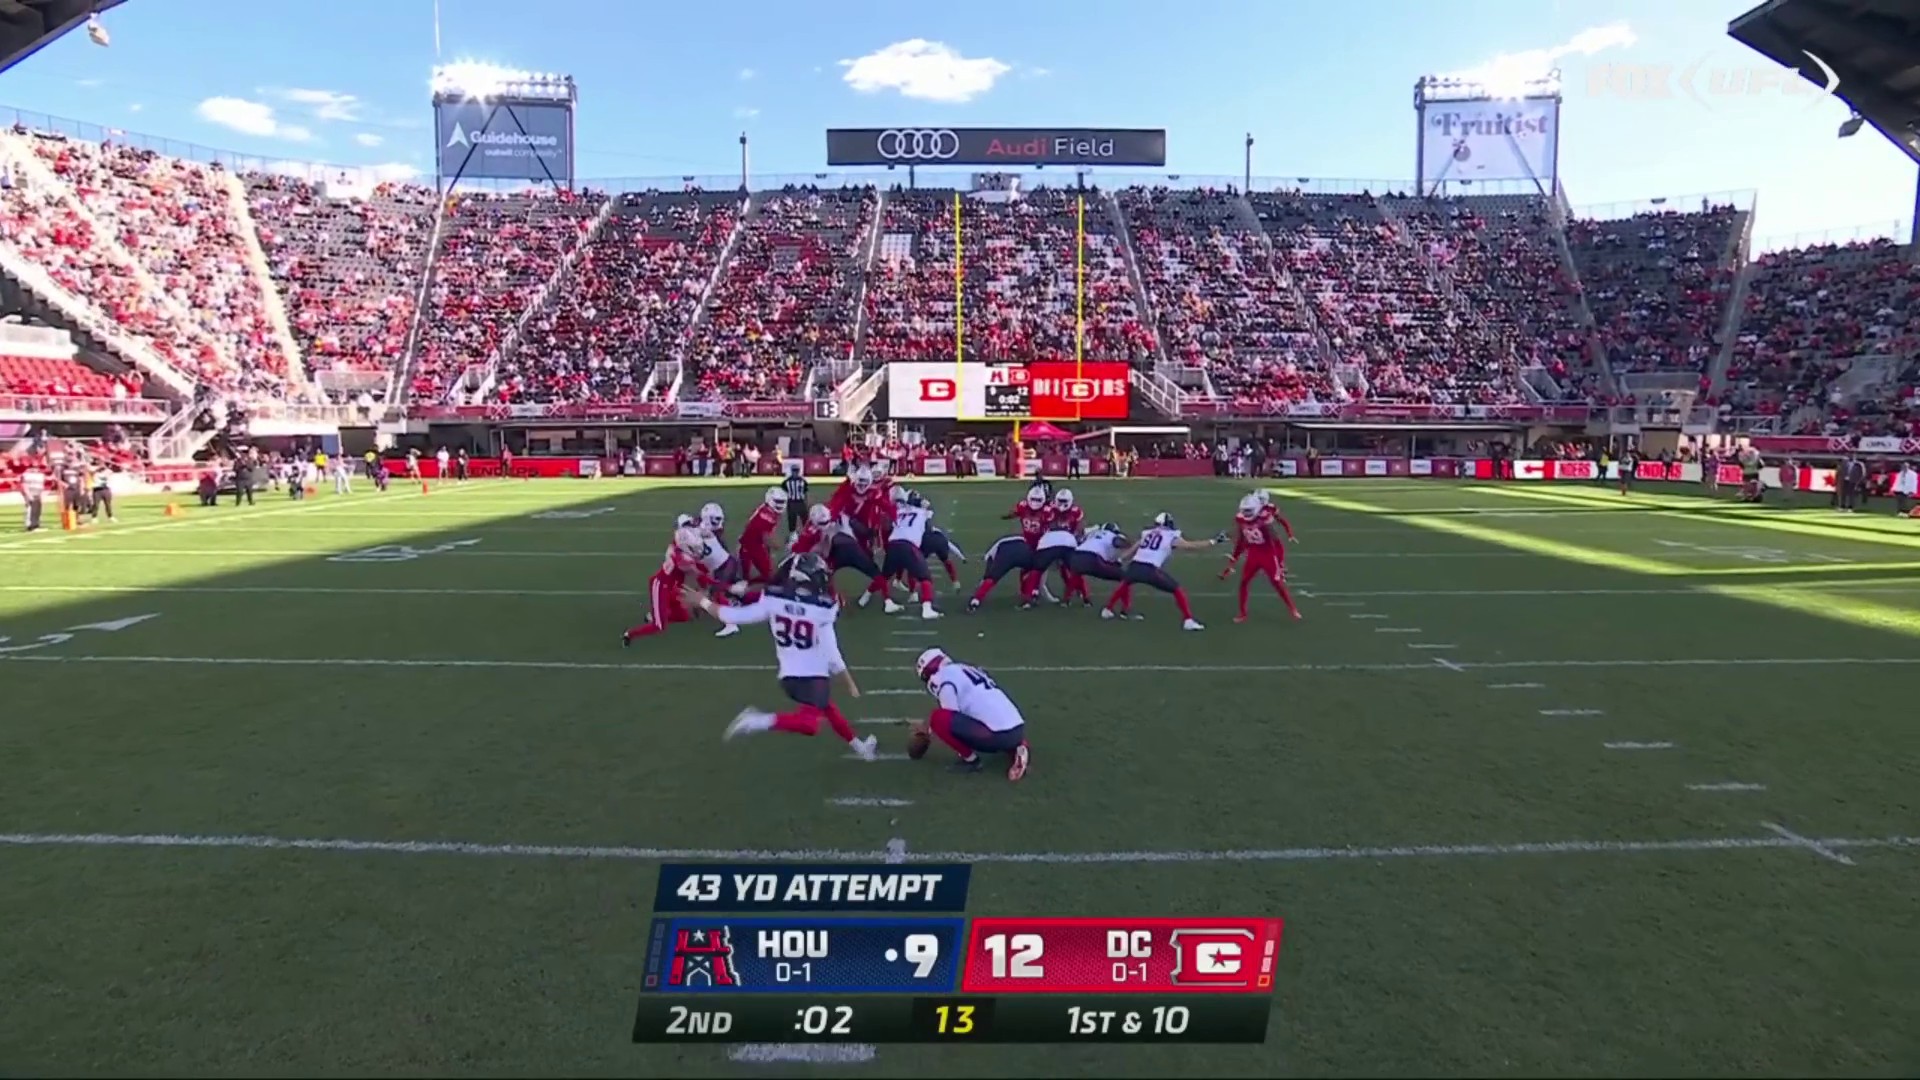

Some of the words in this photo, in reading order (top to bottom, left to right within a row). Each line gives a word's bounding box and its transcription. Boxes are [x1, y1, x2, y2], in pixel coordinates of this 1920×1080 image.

[1431, 112, 1547, 136] Fruitist
[470, 130, 558, 146] Guidehouse
[986, 139, 1047, 156] Audi
[1055, 138, 1113, 157] Field
[823, 400, 839, 417] 13
[775, 614, 814, 650] 39
